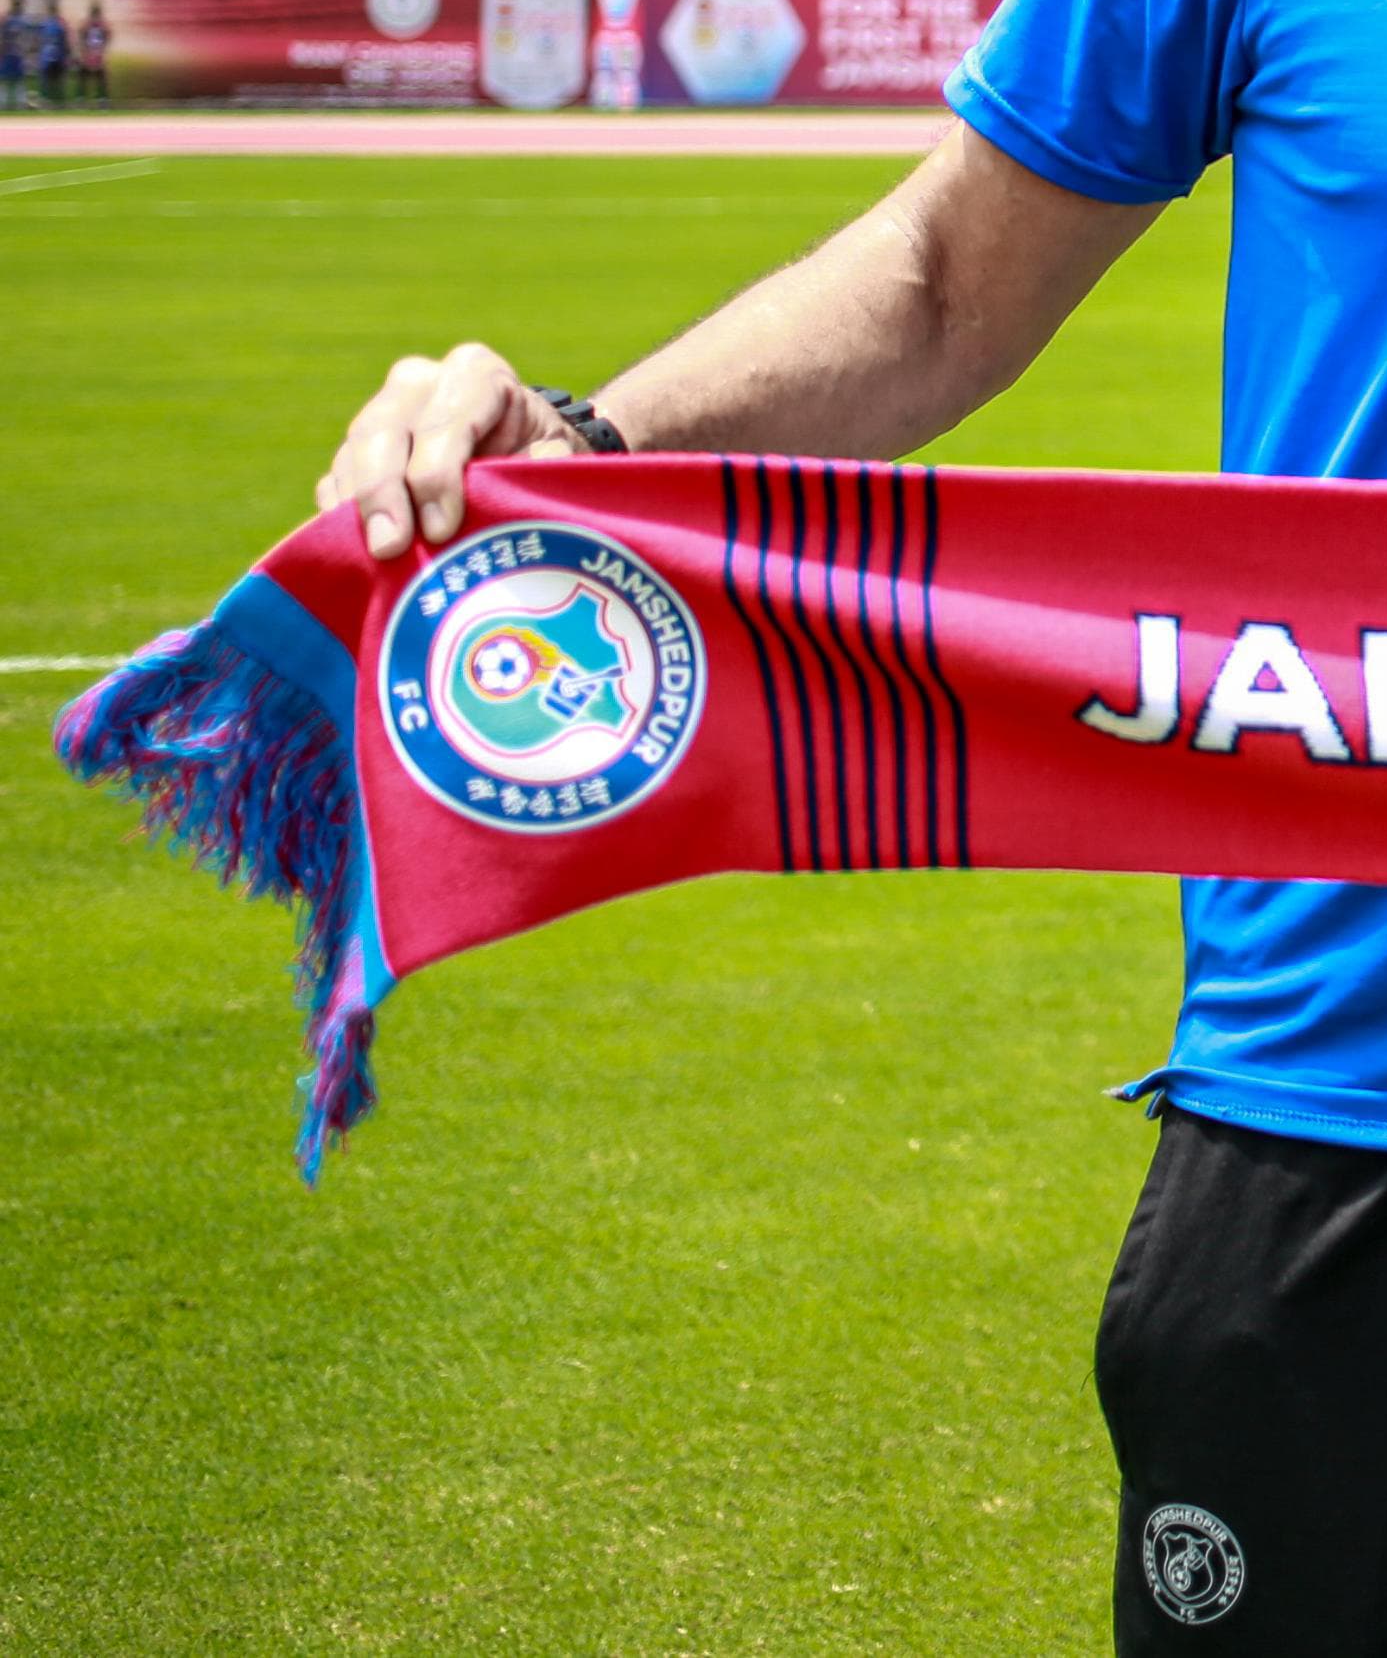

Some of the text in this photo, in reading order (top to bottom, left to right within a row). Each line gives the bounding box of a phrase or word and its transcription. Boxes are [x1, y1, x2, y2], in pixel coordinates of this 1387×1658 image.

[580, 550, 692, 765] JAMSHEDPUR
[392, 679, 429, 733] FC
[1151, 1508, 1228, 1543] JAMSHEDPUR
